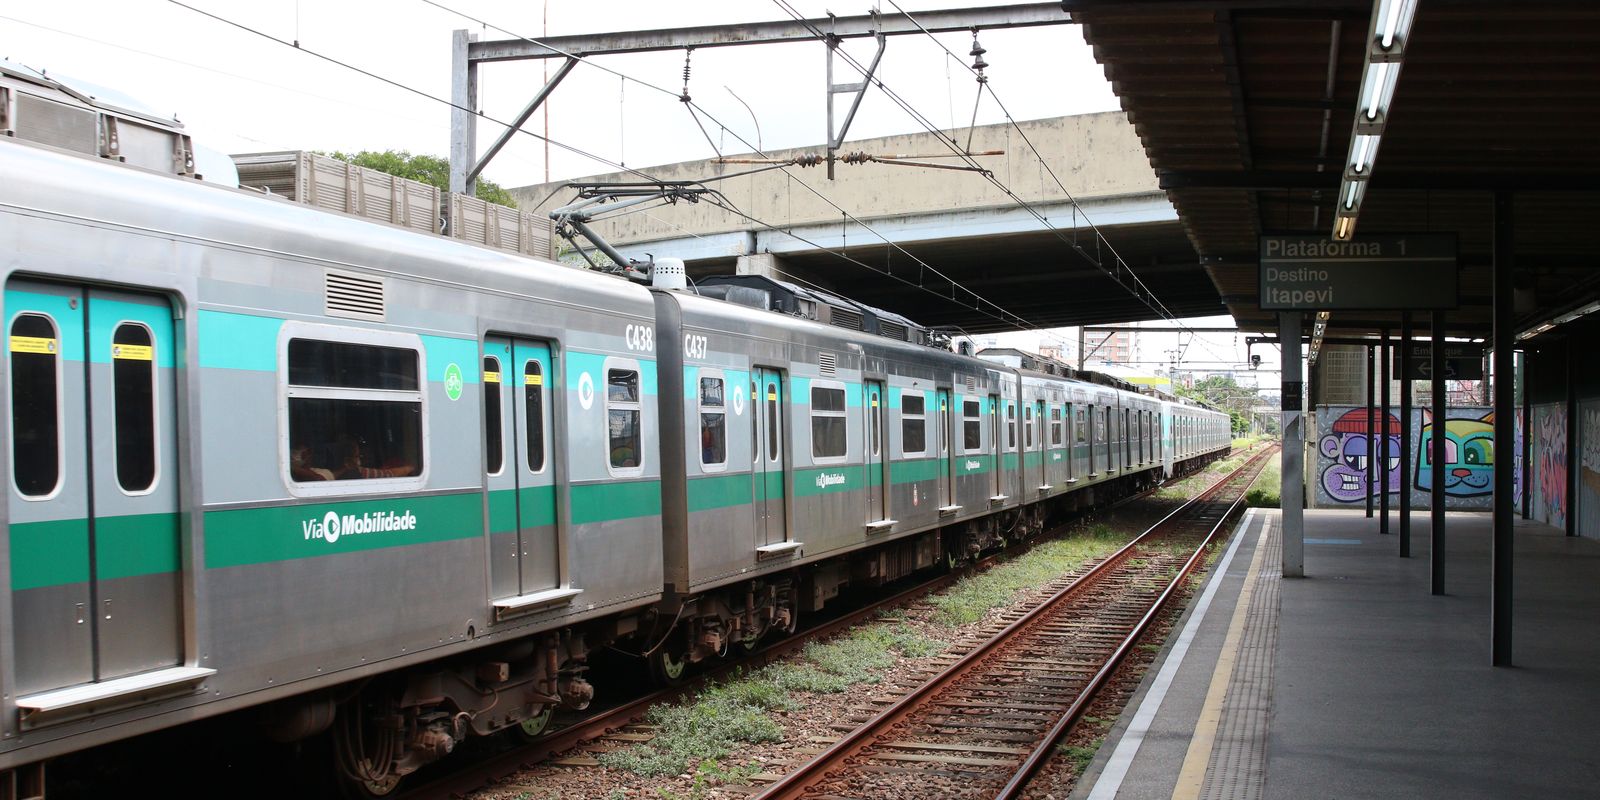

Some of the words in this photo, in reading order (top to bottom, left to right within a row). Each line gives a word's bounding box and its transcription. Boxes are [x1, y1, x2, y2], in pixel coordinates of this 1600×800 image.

[1266, 239, 1382, 257] Plataforma
[1396, 240, 1408, 256] 1
[1266, 267, 1328, 282] Destino
[1266, 286, 1333, 307] Itapevi
[625, 324, 653, 352] C438
[684, 333, 707, 360] C437
